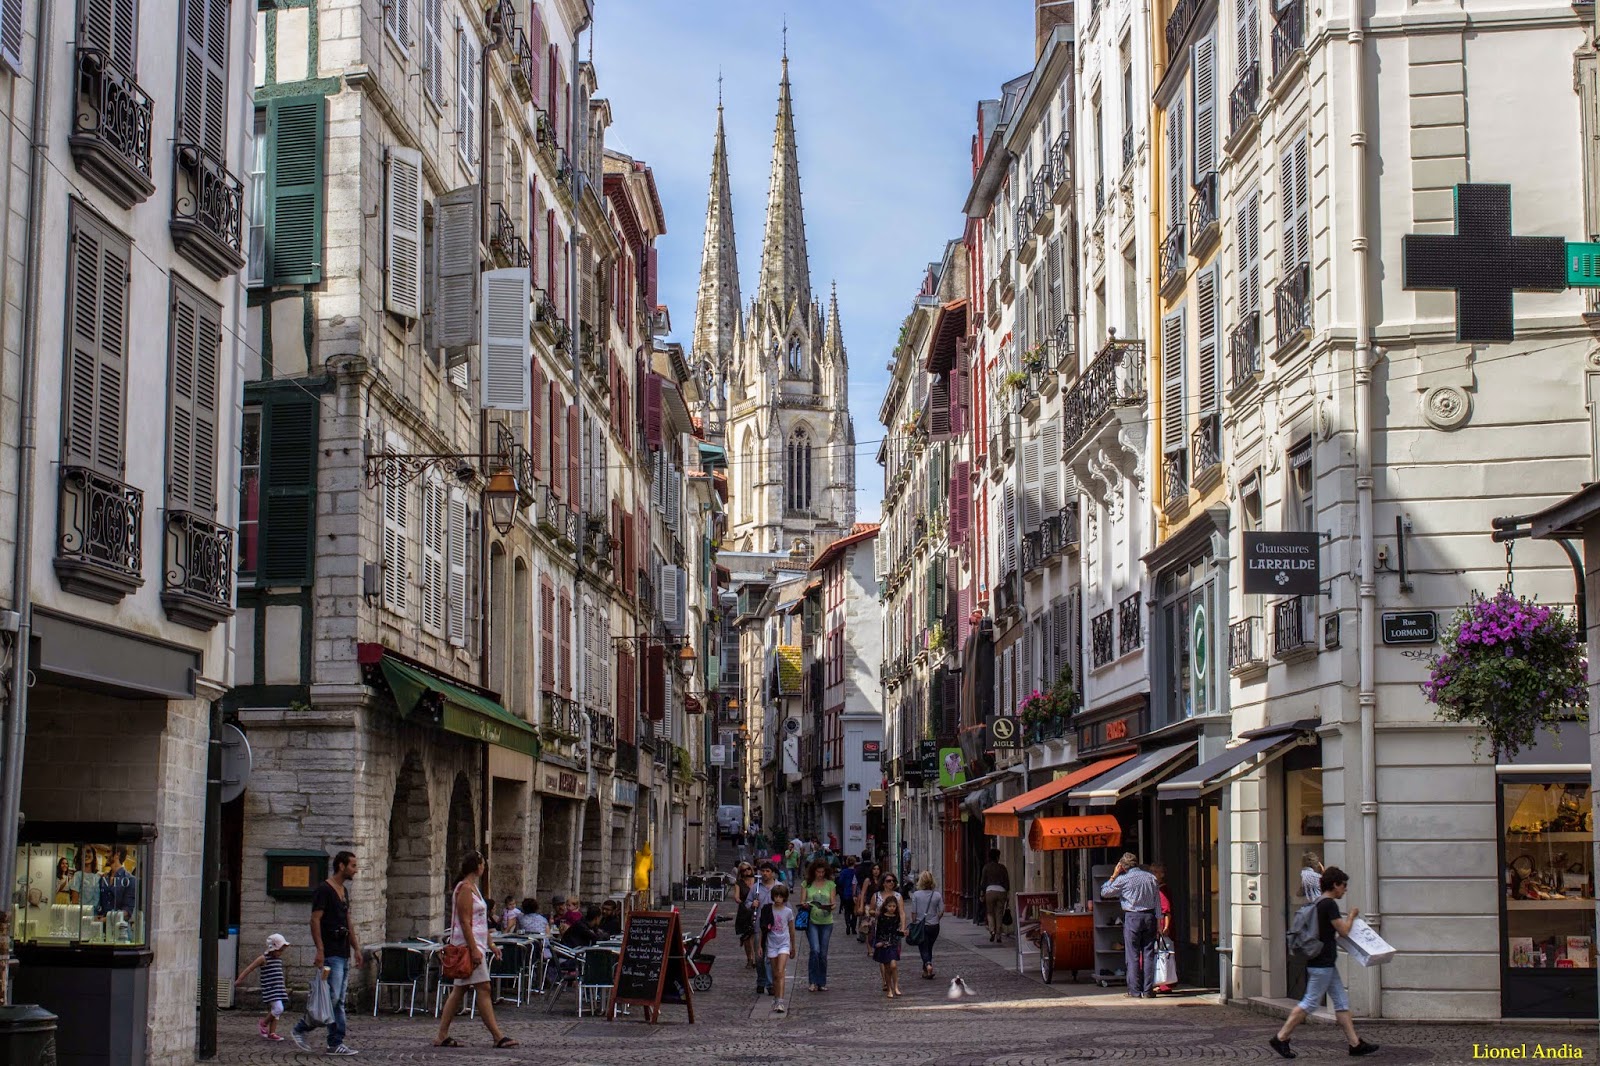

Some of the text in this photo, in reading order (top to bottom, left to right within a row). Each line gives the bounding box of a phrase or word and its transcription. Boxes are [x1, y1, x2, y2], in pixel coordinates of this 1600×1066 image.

[1255, 542, 1310, 554] Chaussures
[1248, 559, 1316, 570] LARRALDE
[1402, 618, 1417, 626] Rue
[1390, 628, 1429, 638] LORMAND
[923, 740, 937, 748] HOT
[993, 740, 1015, 748] AIGLE
[922, 752, 936, 761] ARCE
[1049, 824, 1115, 835] GLACES
[1060, 834, 1108, 848] PARIES
[20, 848, 52, 857] SNTO
[1069, 930, 1094, 940] PARI
